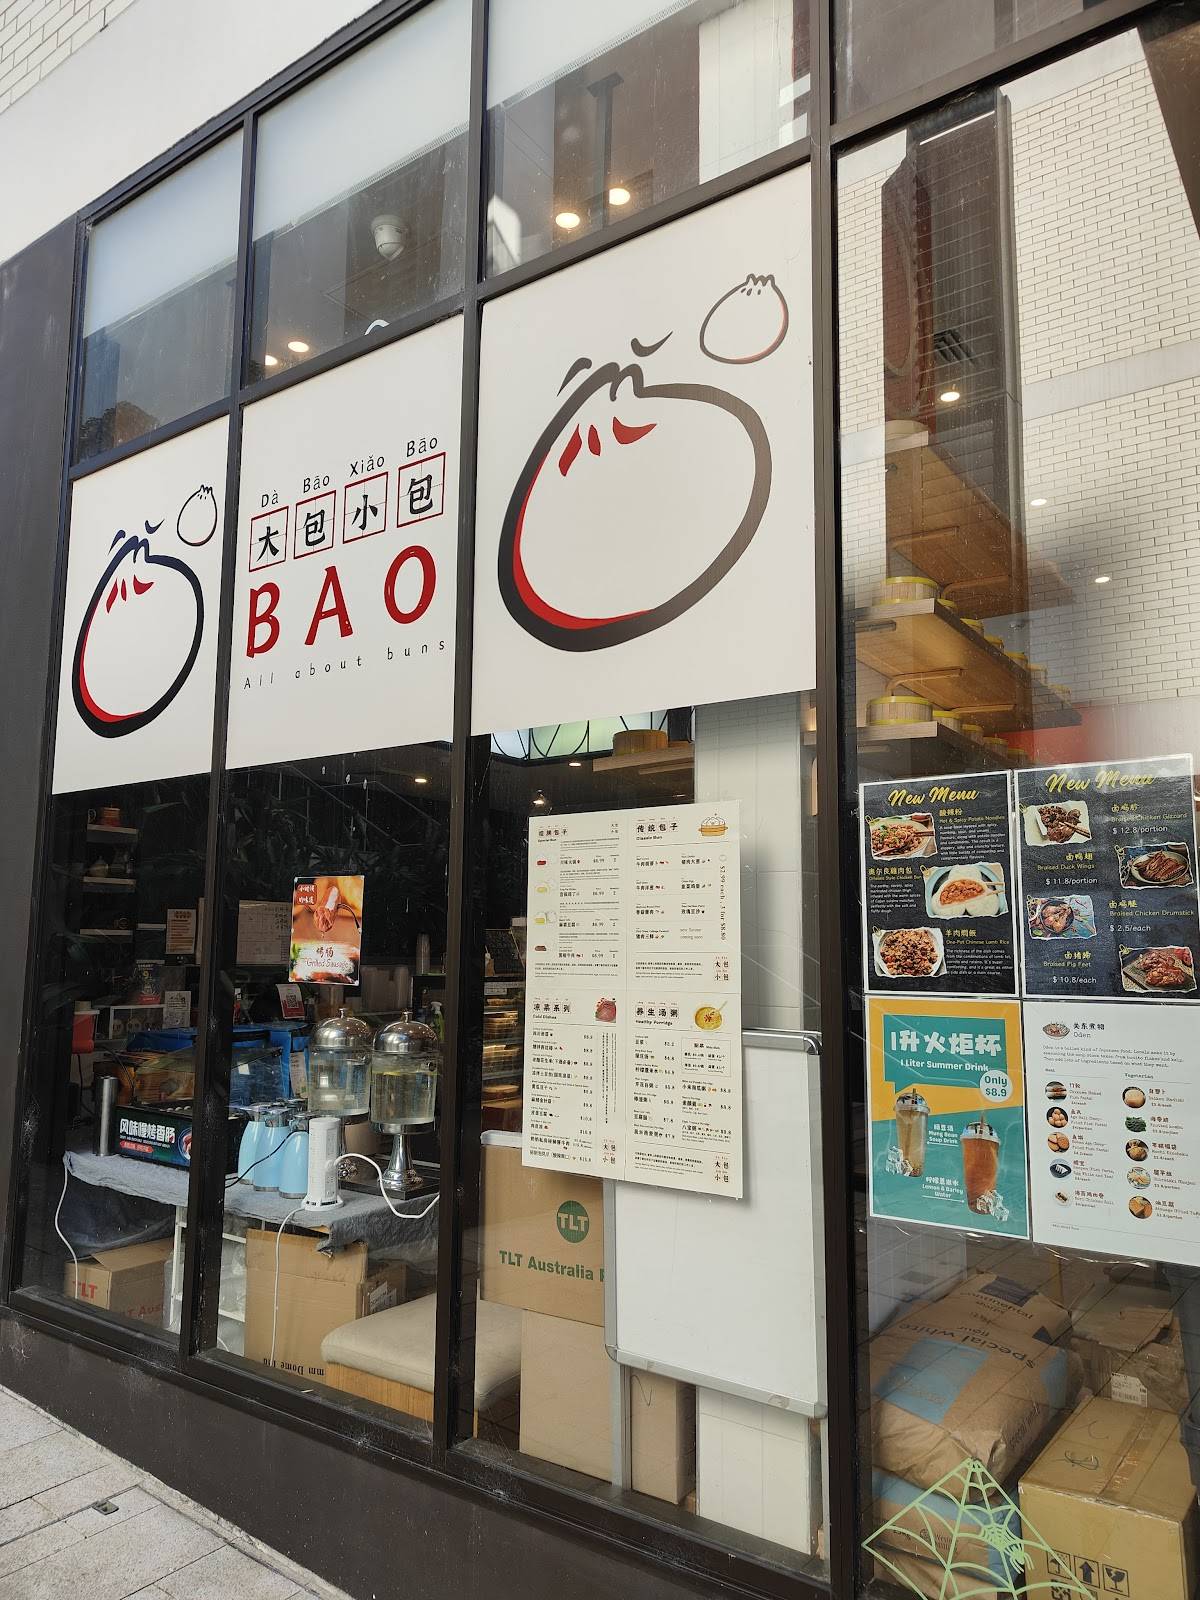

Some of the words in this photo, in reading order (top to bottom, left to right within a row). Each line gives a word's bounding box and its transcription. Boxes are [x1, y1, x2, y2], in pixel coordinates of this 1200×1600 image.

[261, 489, 279, 508] Dà
[303, 474, 330, 493] Bāo
[350, 455, 385, 477] Xiǎo
[406, 436, 438, 457] Bāo
[256, 474, 434, 562] 大包小包
[246, 545, 437, 658] BAO
[244, 672, 274, 689] All
[295, 656, 362, 679] about
[387, 640, 445, 660] buns
[1045, 773, 1091, 793] New
[1095, 769, 1155, 789] Menu
[888, 789, 926, 807] New
[928, 786, 980, 803] Menu
[1120, 826, 1168, 835] 12.8/portion
[1053, 877, 1098, 885] 11.8/portion
[1117, 924, 1151, 932] 2.5/each
[1060, 976, 1097, 984] 10.8/each
[905, 1059, 924, 1067] Liter
[926, 1061, 962, 1070] Summer
[964, 1062, 989, 1071] Drink
[984, 1076, 1008, 1088] Only
[985, 1088, 1007, 1097] $8.9
[928, 1130, 943, 1138] Mung
[946, 1187, 964, 1195] Barley
[557, 1212, 589, 1232] TLT
[499, 1250, 523, 1267] TLT
[528, 1256, 594, 1281] Australia
[899, 1322, 955, 1339] white
[960, 1335, 1035, 1369] special
